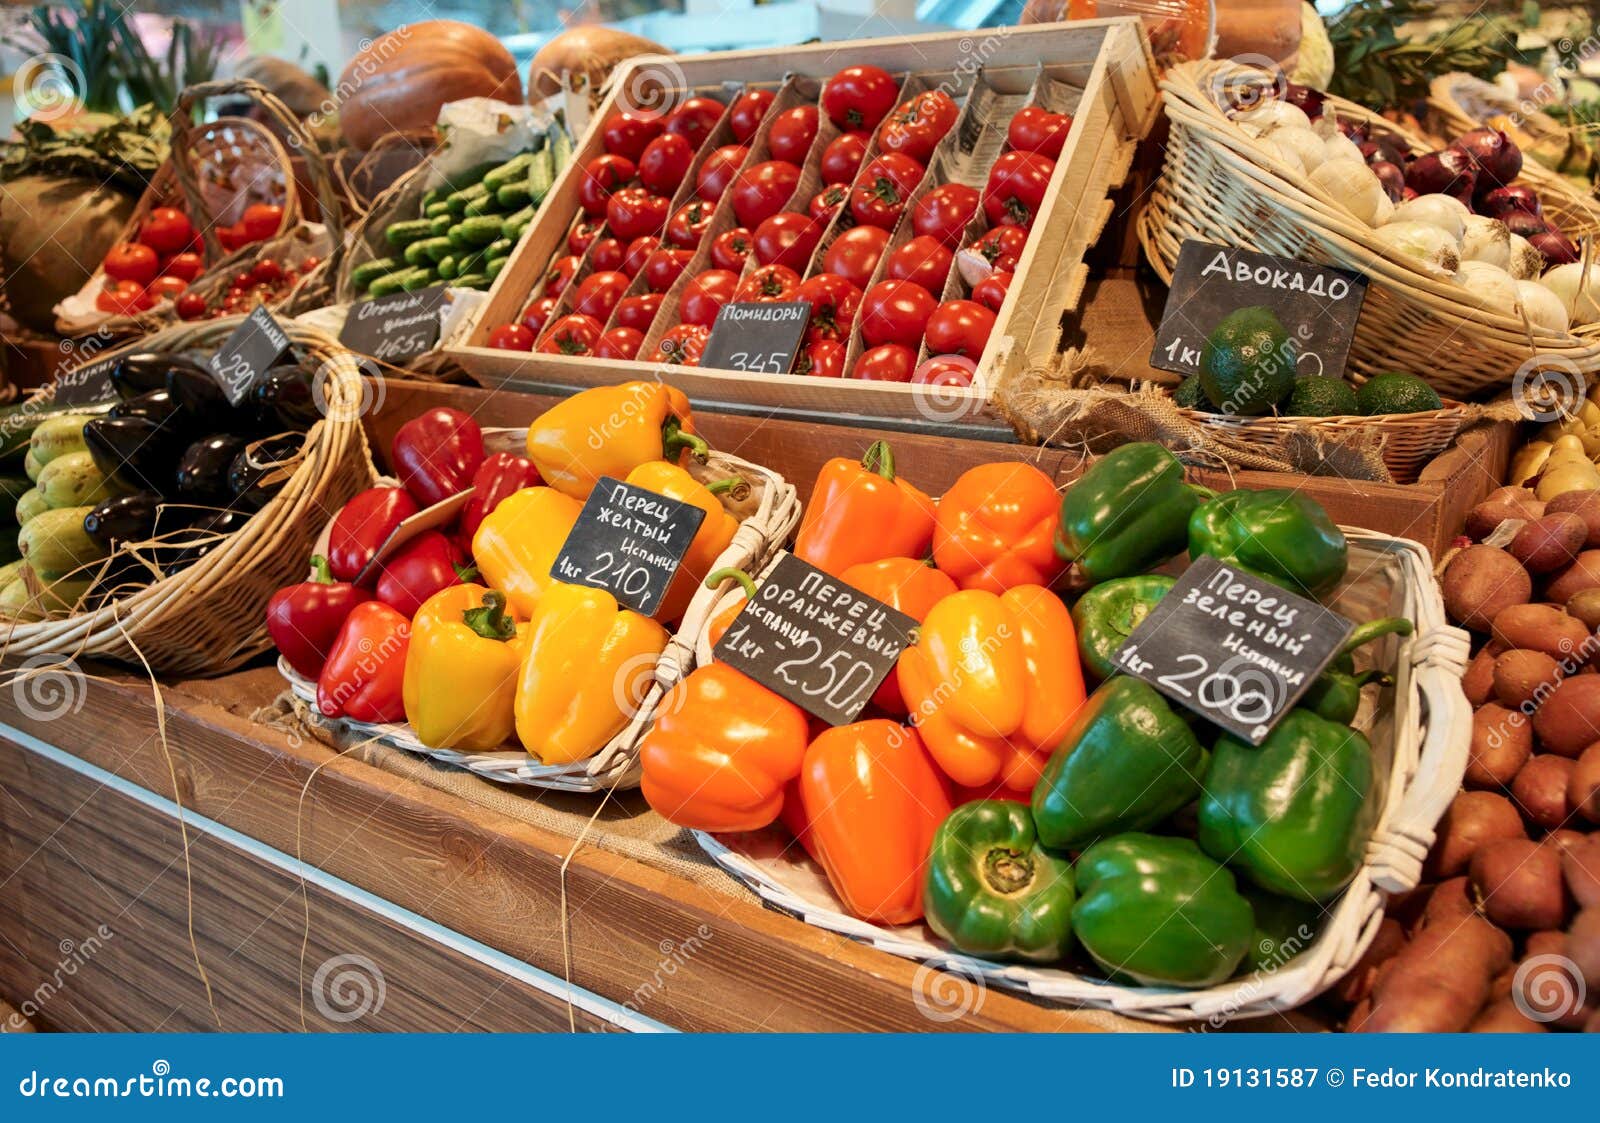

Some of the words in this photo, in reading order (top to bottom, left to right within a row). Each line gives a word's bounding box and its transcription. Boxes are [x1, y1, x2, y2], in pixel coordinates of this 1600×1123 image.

[730, 352, 788, 374] 345
[609, 484, 669, 522] Перец
[798, 572, 887, 632] ПЕРЕЦ
[1207, 568, 1298, 628] Перец
[724, 624, 764, 659] 1кг
